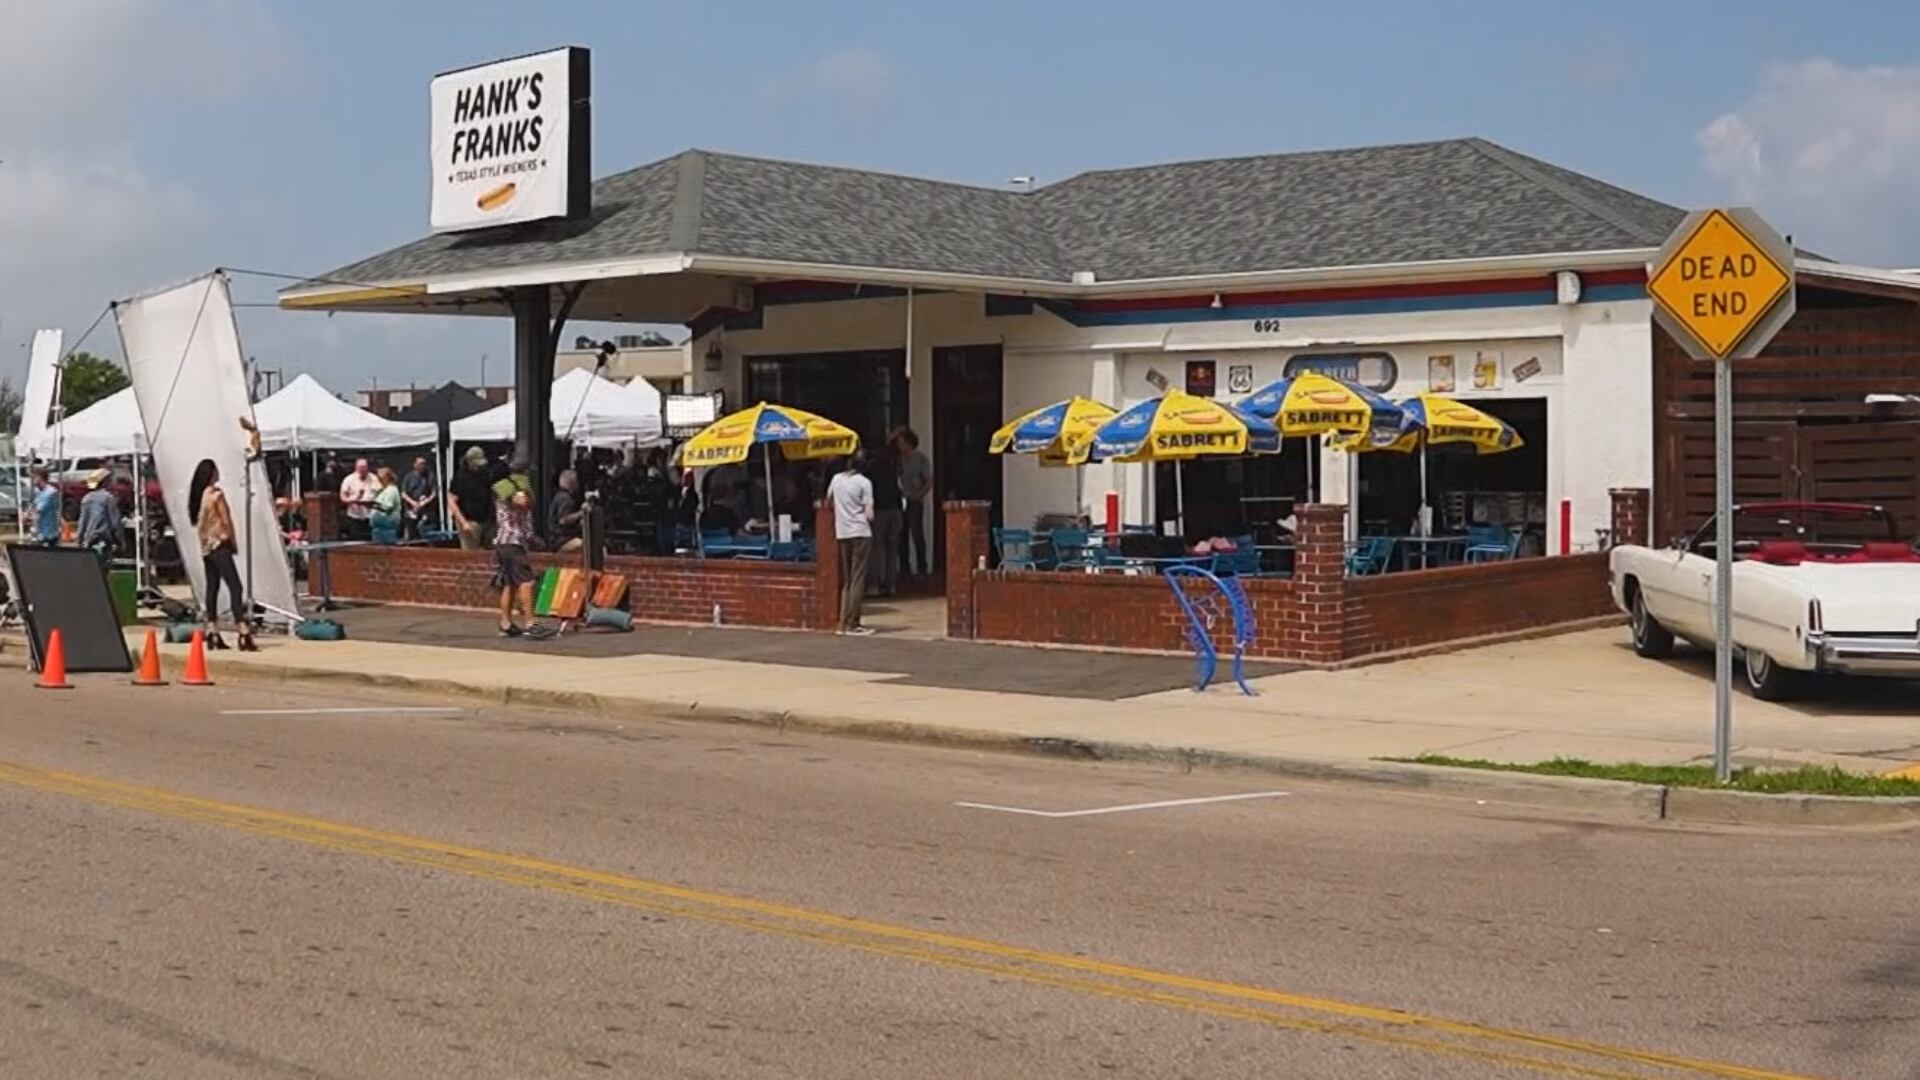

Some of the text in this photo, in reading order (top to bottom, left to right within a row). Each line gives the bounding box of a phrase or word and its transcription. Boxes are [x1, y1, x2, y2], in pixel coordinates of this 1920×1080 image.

[454, 72, 543, 124] HANK'S
[452, 115, 543, 165] FRANKS
[1681, 254, 1756, 281] DEAD
[1694, 291, 1747, 317] END
[1254, 320, 1280, 332] 692
[1233, 375, 1249, 388] 66
[1287, 411, 1363, 425] SABRETT
[1157, 432, 1238, 449] SABRETT
